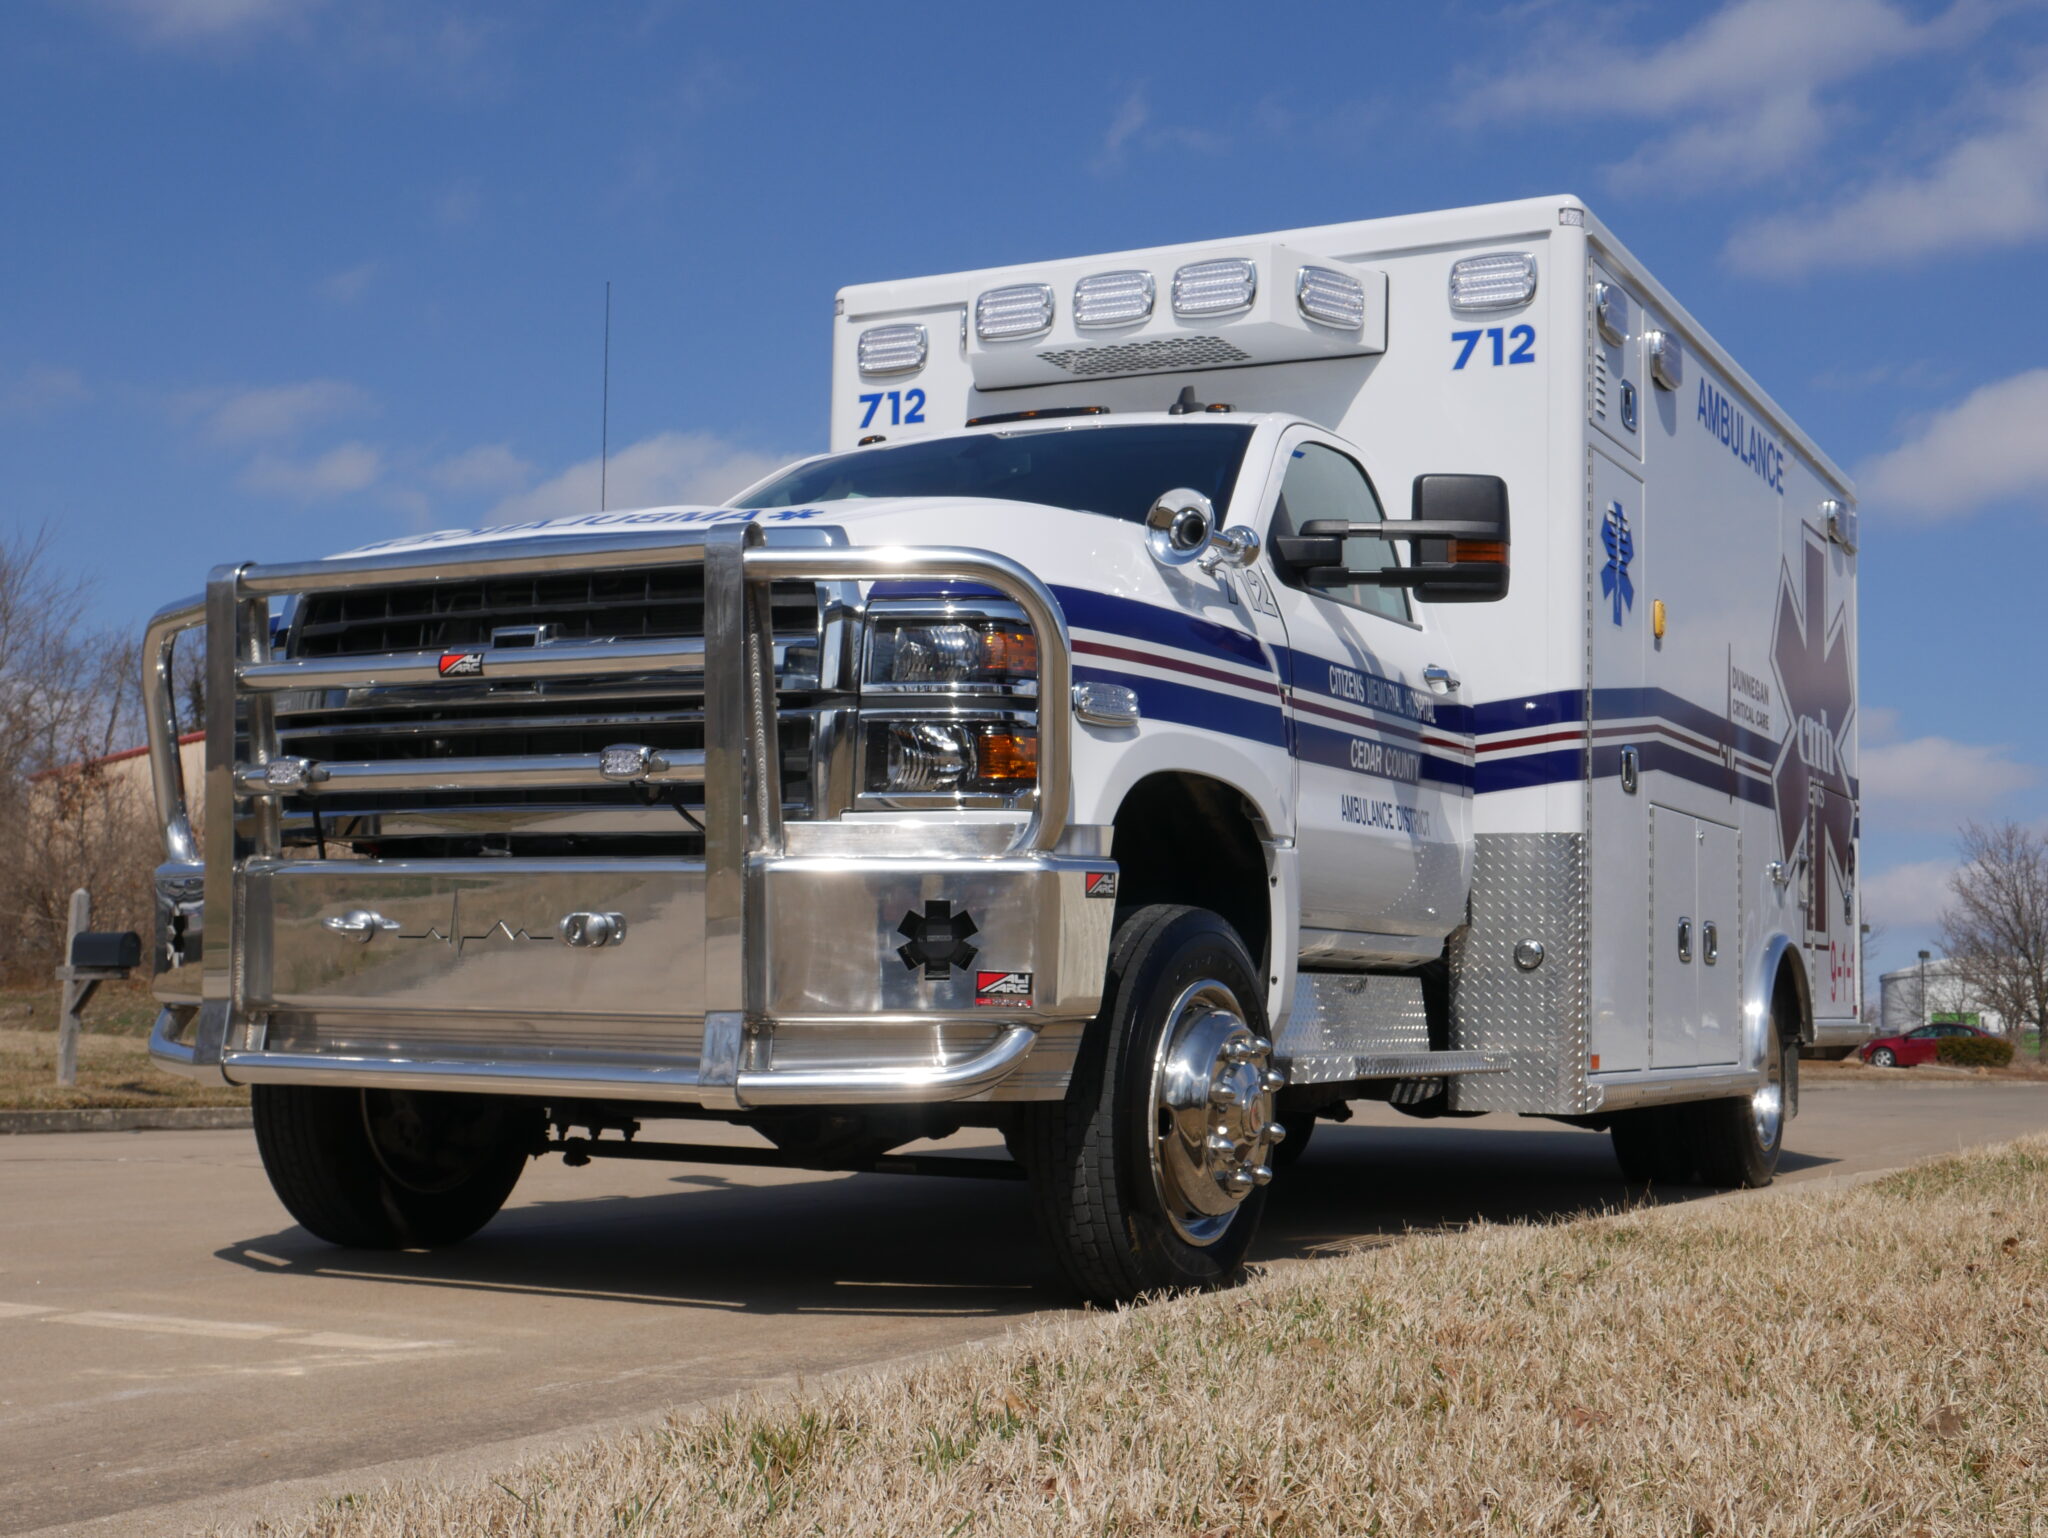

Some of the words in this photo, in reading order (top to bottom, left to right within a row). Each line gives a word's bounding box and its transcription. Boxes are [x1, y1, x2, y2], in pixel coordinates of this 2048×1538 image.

[1451, 323, 1536, 370] 712
[858, 387, 926, 428] 712
[1697, 376, 1784, 496] AMBULANCE
[450, 662, 481, 672] ARC
[1732, 666, 1770, 707] DUNNEGAN
[1329, 664, 1366, 703] CITIZENS
[1366, 677, 1404, 714] MEMORIAL
[1405, 689, 1437, 724] HOSPITAL
[1732, 697, 1755, 725] CRITICAL
[1756, 709, 1770, 731] CARE
[1351, 738, 1382, 773] CEDAR
[1385, 747, 1420, 781] COUNTY
[1797, 708, 1836, 777] cmh
[1341, 793, 1395, 830] AMBULANCE
[1396, 804, 1431, 838] DISTRICT
[989, 983, 1029, 994] ARC
